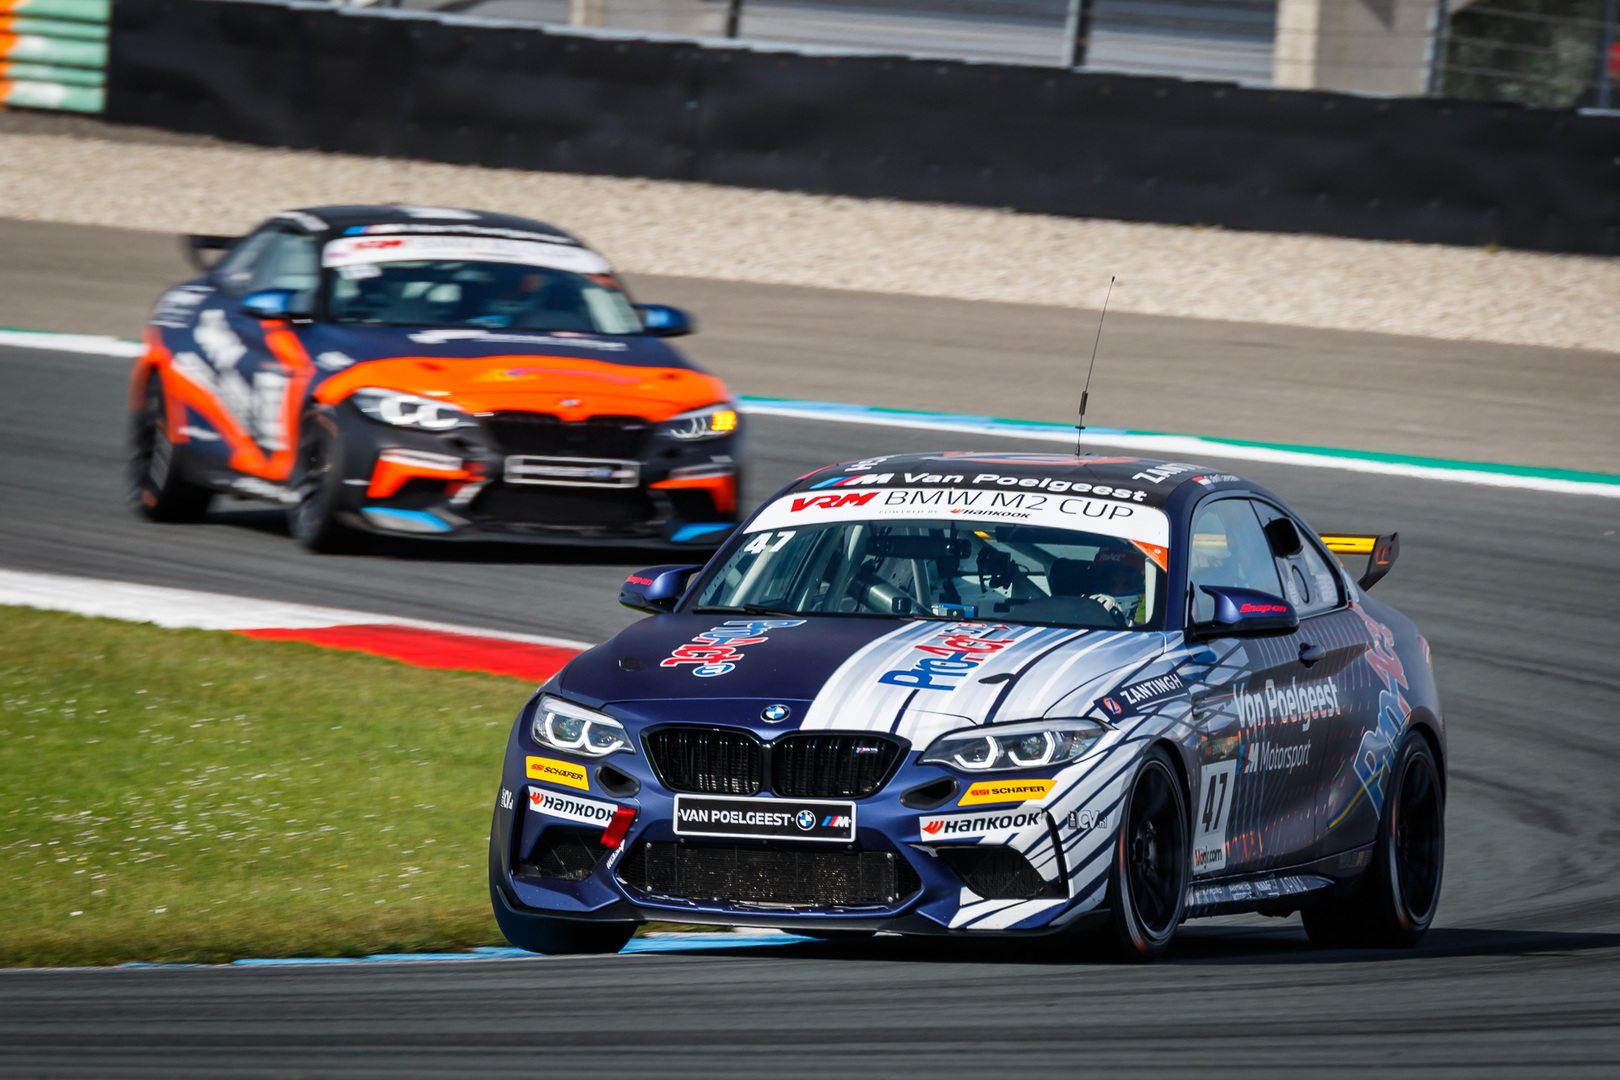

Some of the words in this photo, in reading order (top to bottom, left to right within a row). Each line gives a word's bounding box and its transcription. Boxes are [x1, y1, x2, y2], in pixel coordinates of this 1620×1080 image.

[790, 492, 881, 512] VRM
[904, 472, 964, 484] Van
[972, 473, 1147, 502] Poelgeest
[884, 490, 983, 506] BMW
[991, 492, 1048, 511] M2
[1059, 498, 1134, 520] CUP
[743, 530, 797, 555] 47
[1239, 603, 1287, 613] Snap-on
[1120, 673, 1184, 705] ZANTINGH
[1232, 682, 1267, 728] Van
[1265, 675, 1341, 732] Poelgeest
[1260, 739, 1312, 775] Motorsport
[970, 788, 990, 796] SSI
[1202, 772, 1229, 833] 47
[680, 808, 709, 823] VAN
[711, 809, 791, 827] POELGEEST
